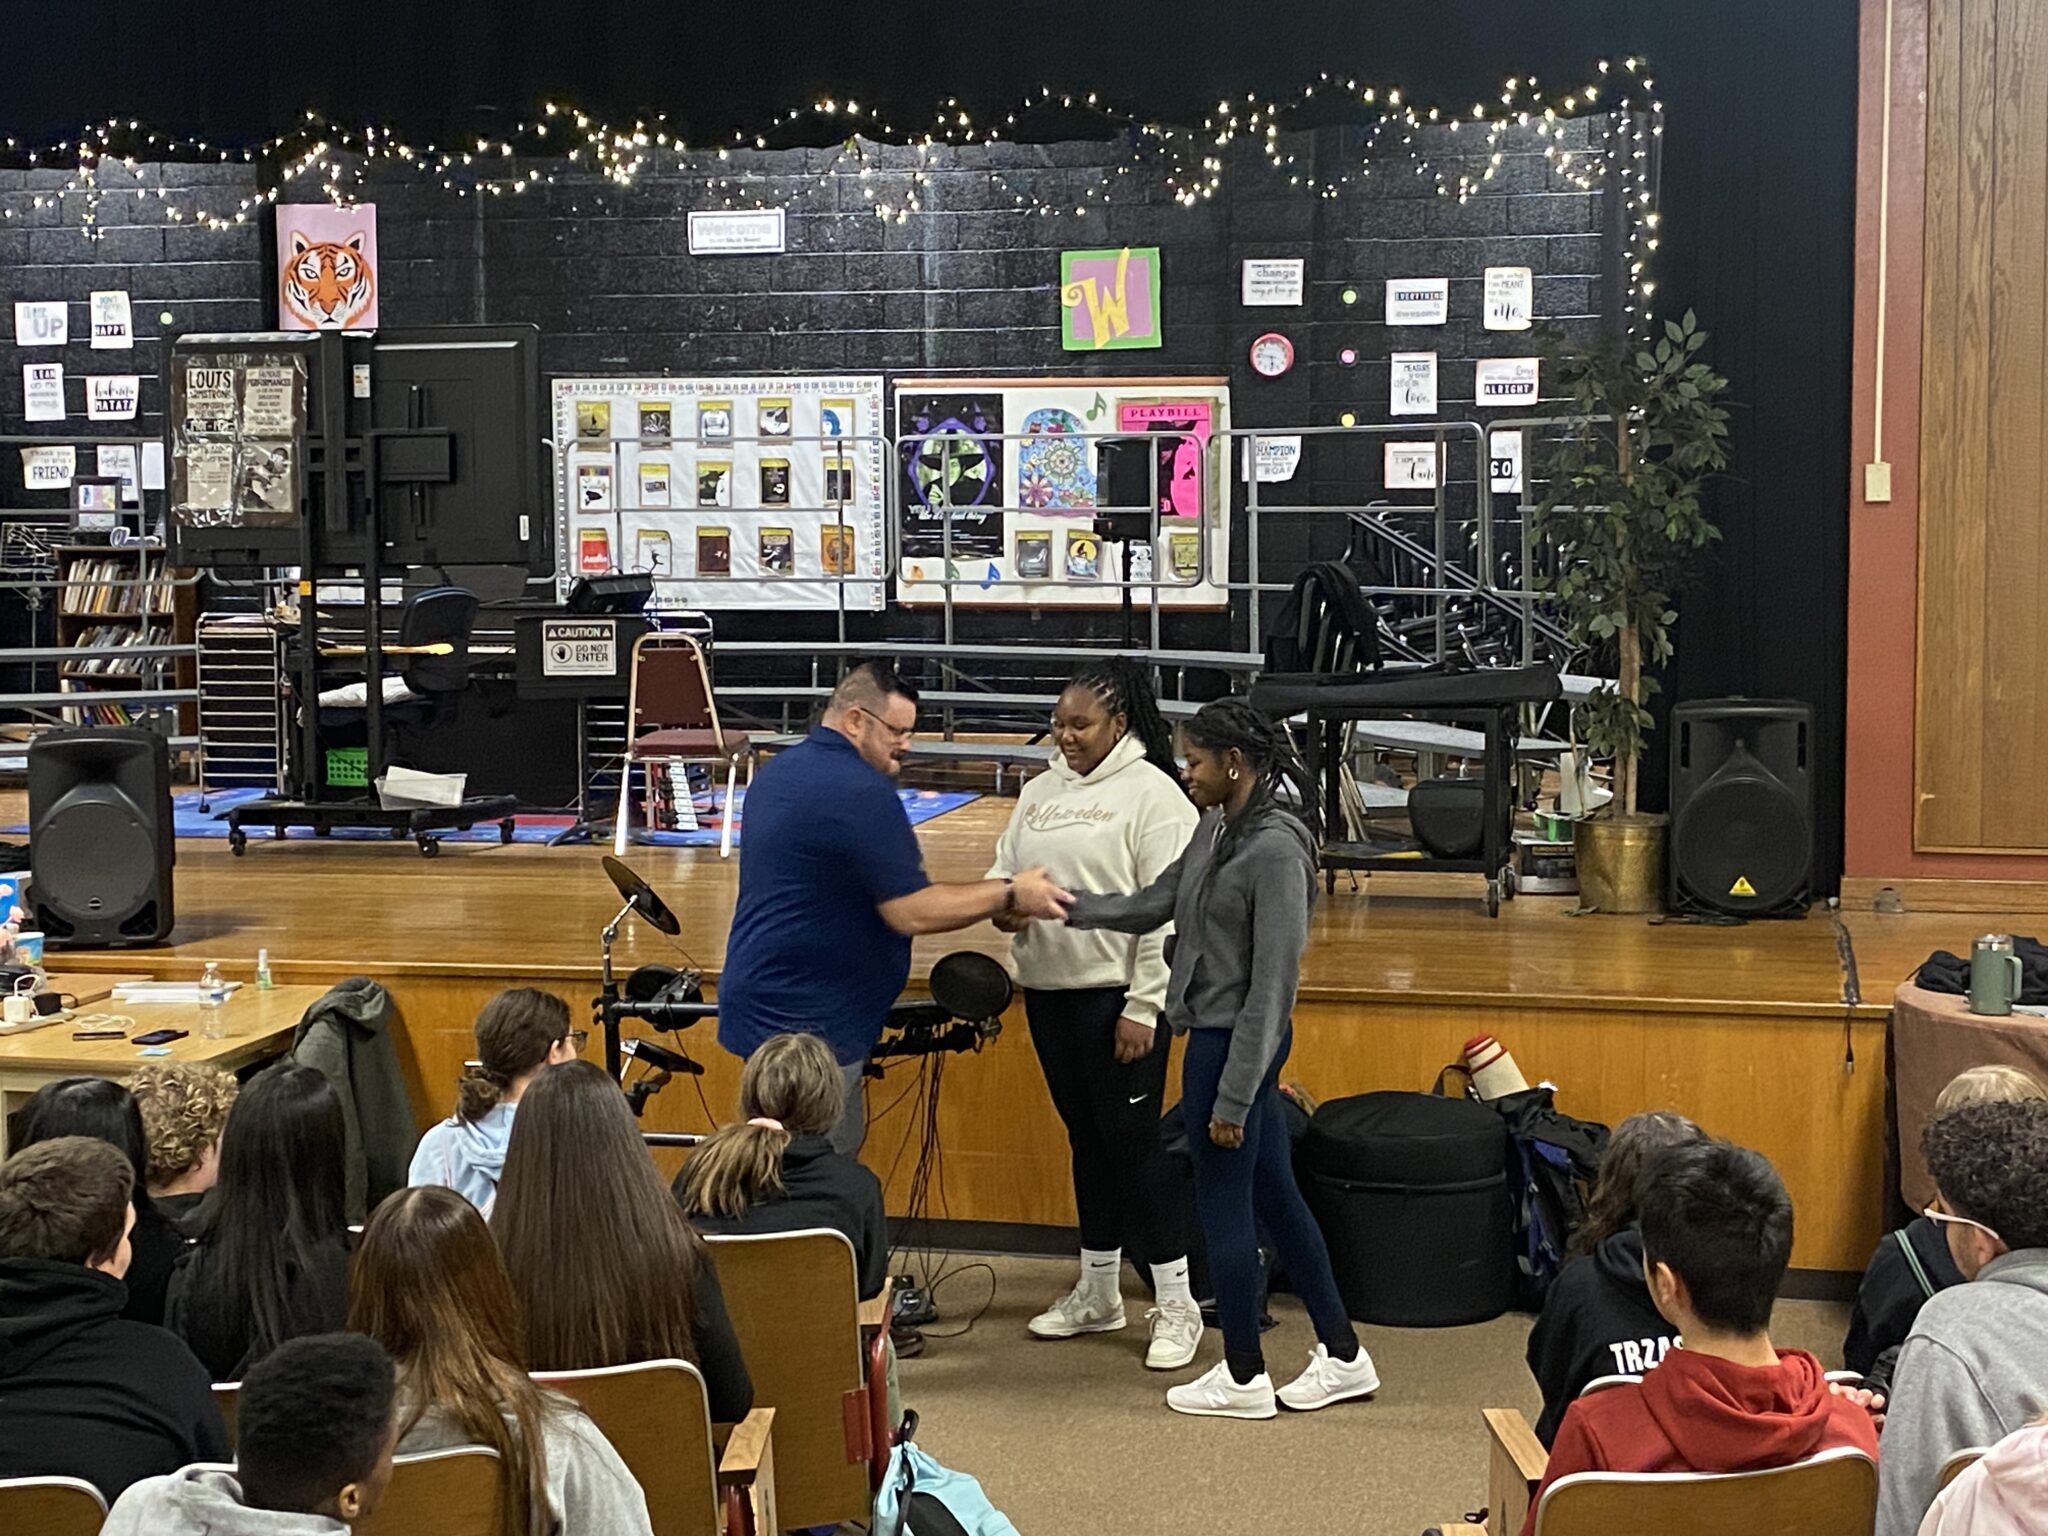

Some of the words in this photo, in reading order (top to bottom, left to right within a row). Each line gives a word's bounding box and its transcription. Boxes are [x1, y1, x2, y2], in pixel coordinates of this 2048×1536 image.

[697, 220, 772, 236] Welcome
[1256, 267, 1296, 280] change
[33, 317, 64, 338] UP
[95, 324, 126, 336] HAPPY
[95, 398, 134, 412] MATATA
[1130, 407, 1202, 418] PLAYBILL
[33, 465, 70, 480] FRIEND
[557, 627, 601, 638] CAUTION
[576, 644, 589, 652] DO
[590, 644, 609, 652] NOT
[576, 652, 609, 662] ENTER
